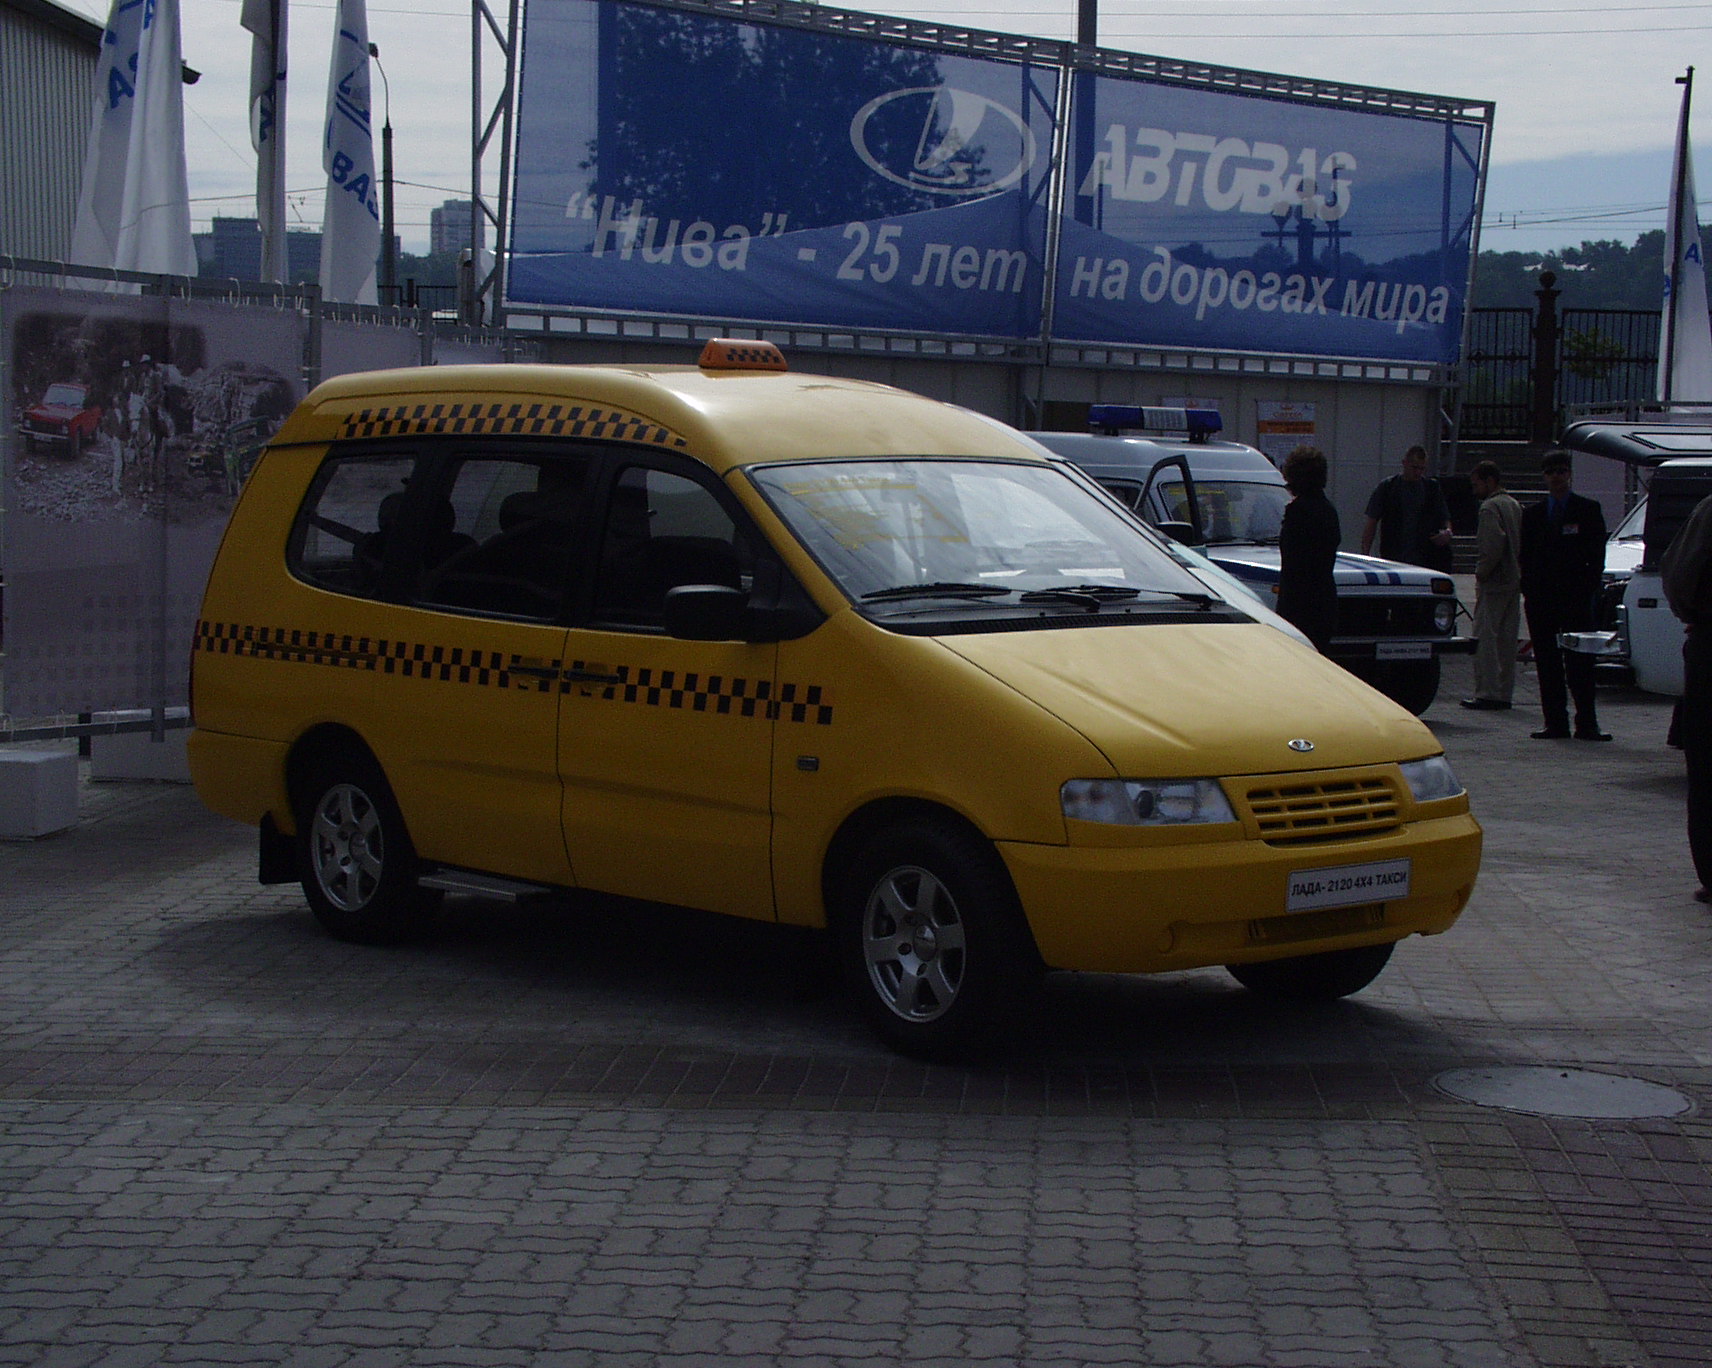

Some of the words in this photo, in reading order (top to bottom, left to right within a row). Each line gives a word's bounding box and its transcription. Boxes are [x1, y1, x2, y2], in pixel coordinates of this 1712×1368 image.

[1078, 123, 1357, 221] АВТОВАЗ
[836, 221, 903, 283] 25
[911, 243, 1028, 293] лет
[1070, 255, 1130, 300] на
[1139, 246, 1335, 321] дорогах
[1340, 280, 1450, 335] мира
[1375, 871, 1407, 886] ТАКСИ
